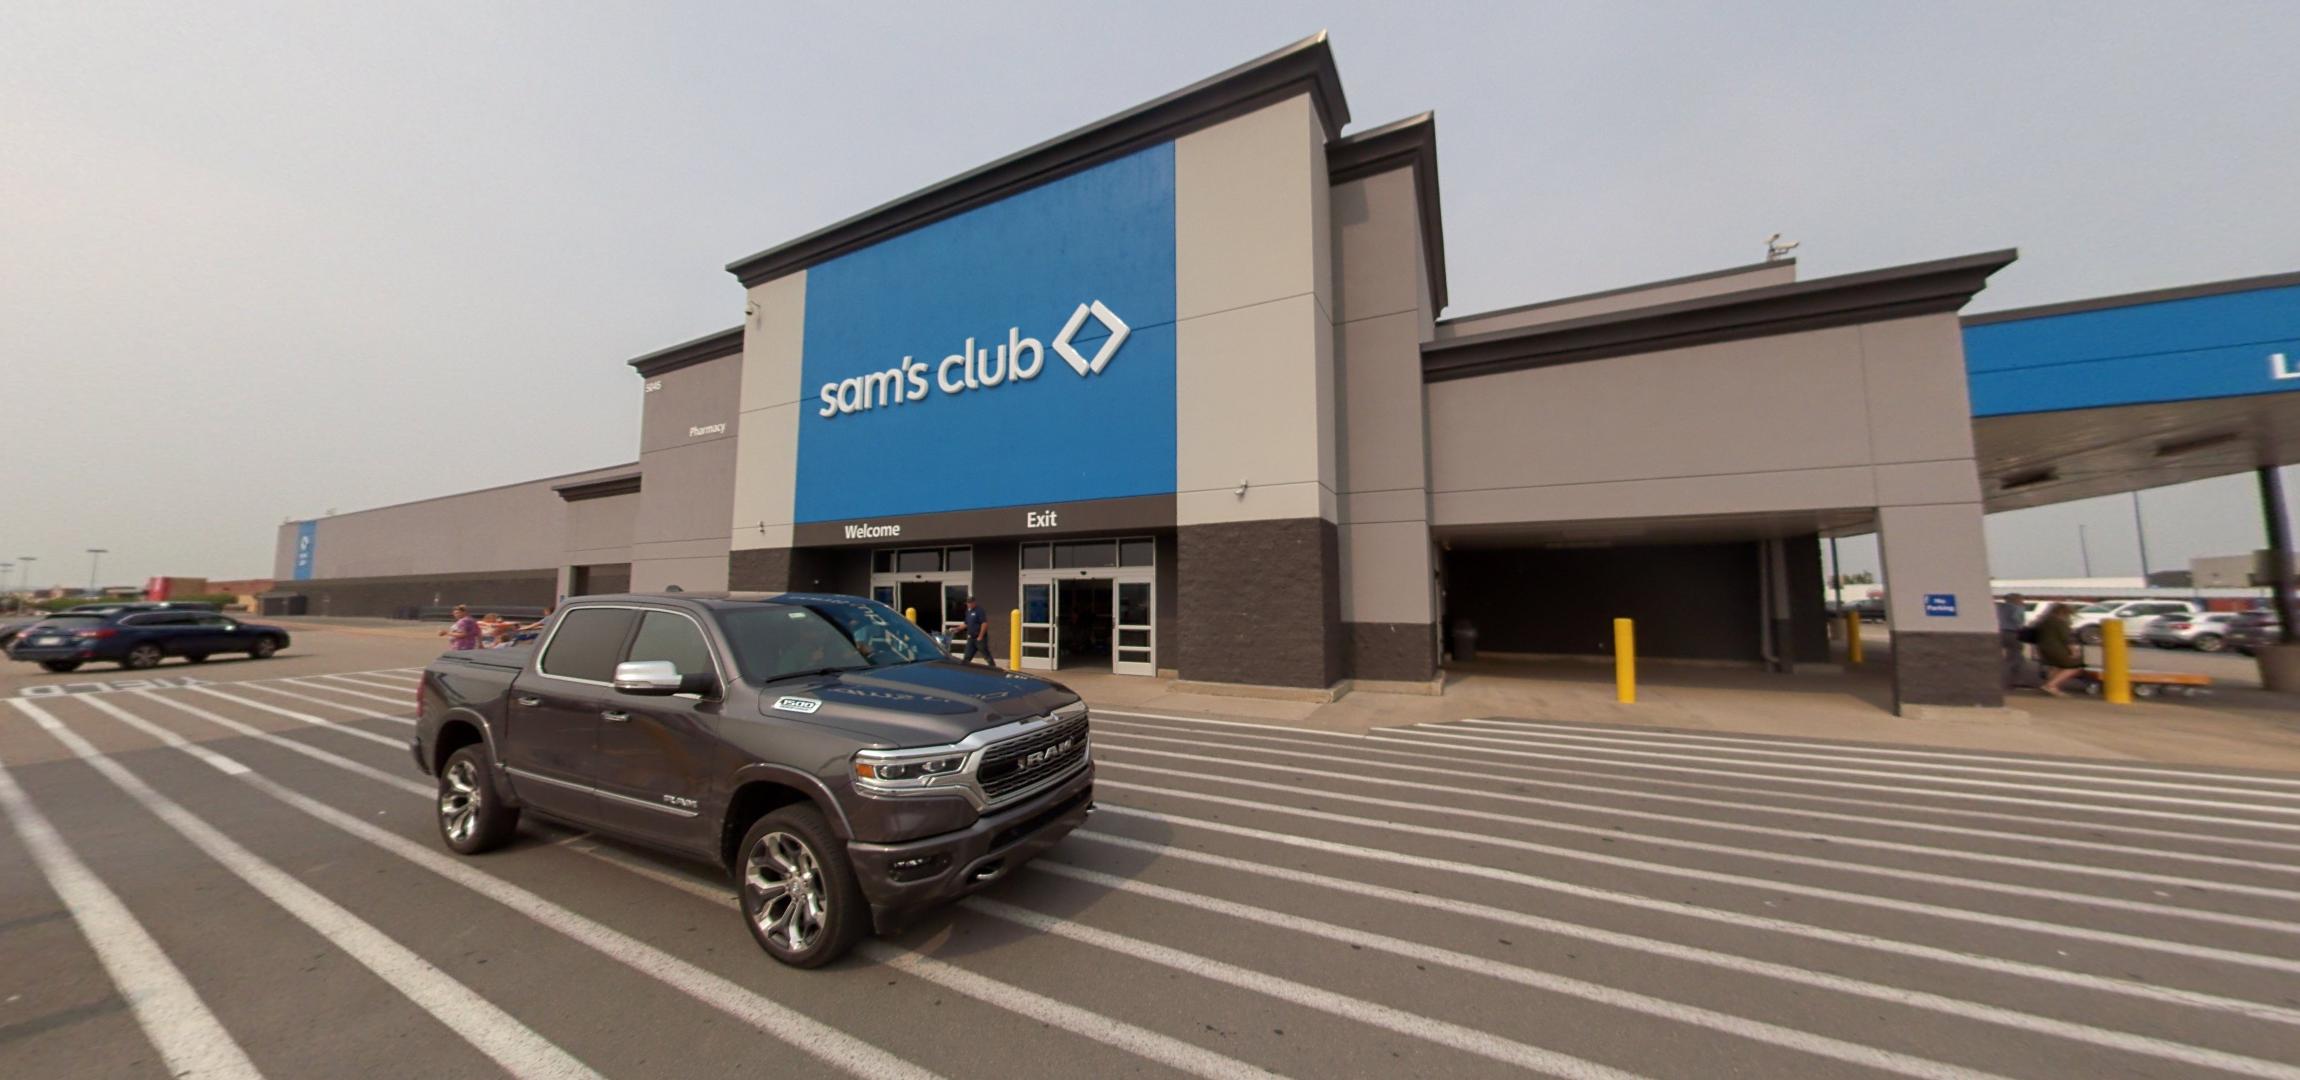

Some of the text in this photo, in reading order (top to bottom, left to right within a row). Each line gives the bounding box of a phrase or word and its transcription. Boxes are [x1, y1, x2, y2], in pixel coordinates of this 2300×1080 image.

[820, 326, 1045, 418] sam's club
[689, 423, 727, 437] Pharmacy
[1027, 510, 1058, 529] Exit
[844, 523, 901, 539] Welcome
[20, 677, 217, 697] YIELD
[1019, 739, 1073, 768] RAM
[664, 795, 698, 809] RAM
